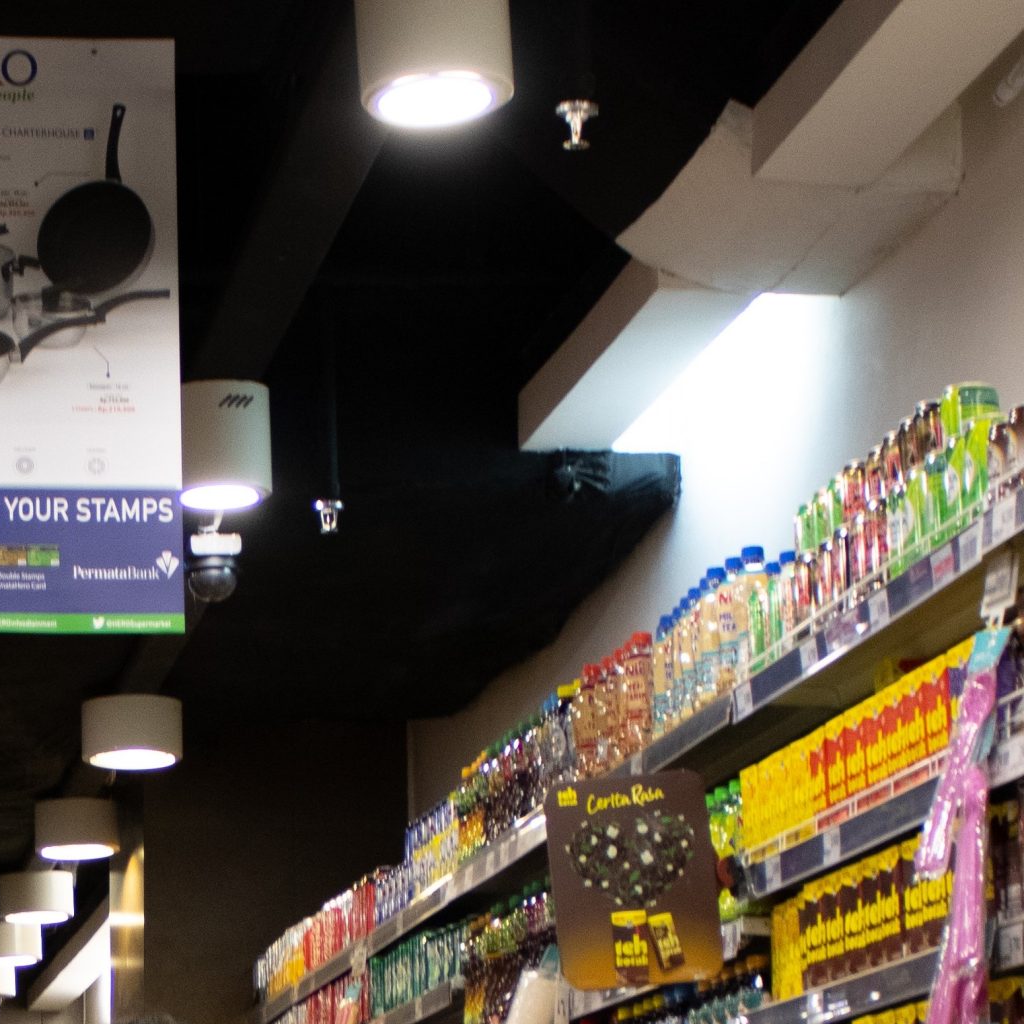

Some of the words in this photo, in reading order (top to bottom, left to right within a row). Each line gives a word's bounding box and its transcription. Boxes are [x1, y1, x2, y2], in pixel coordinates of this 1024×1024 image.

[2, 128, 79, 139] CHARTERHOUSE
[4, 496, 69, 522] YOUR
[76, 497, 174, 523] STAMPS
[73, 564, 160, 580] PermataBank
